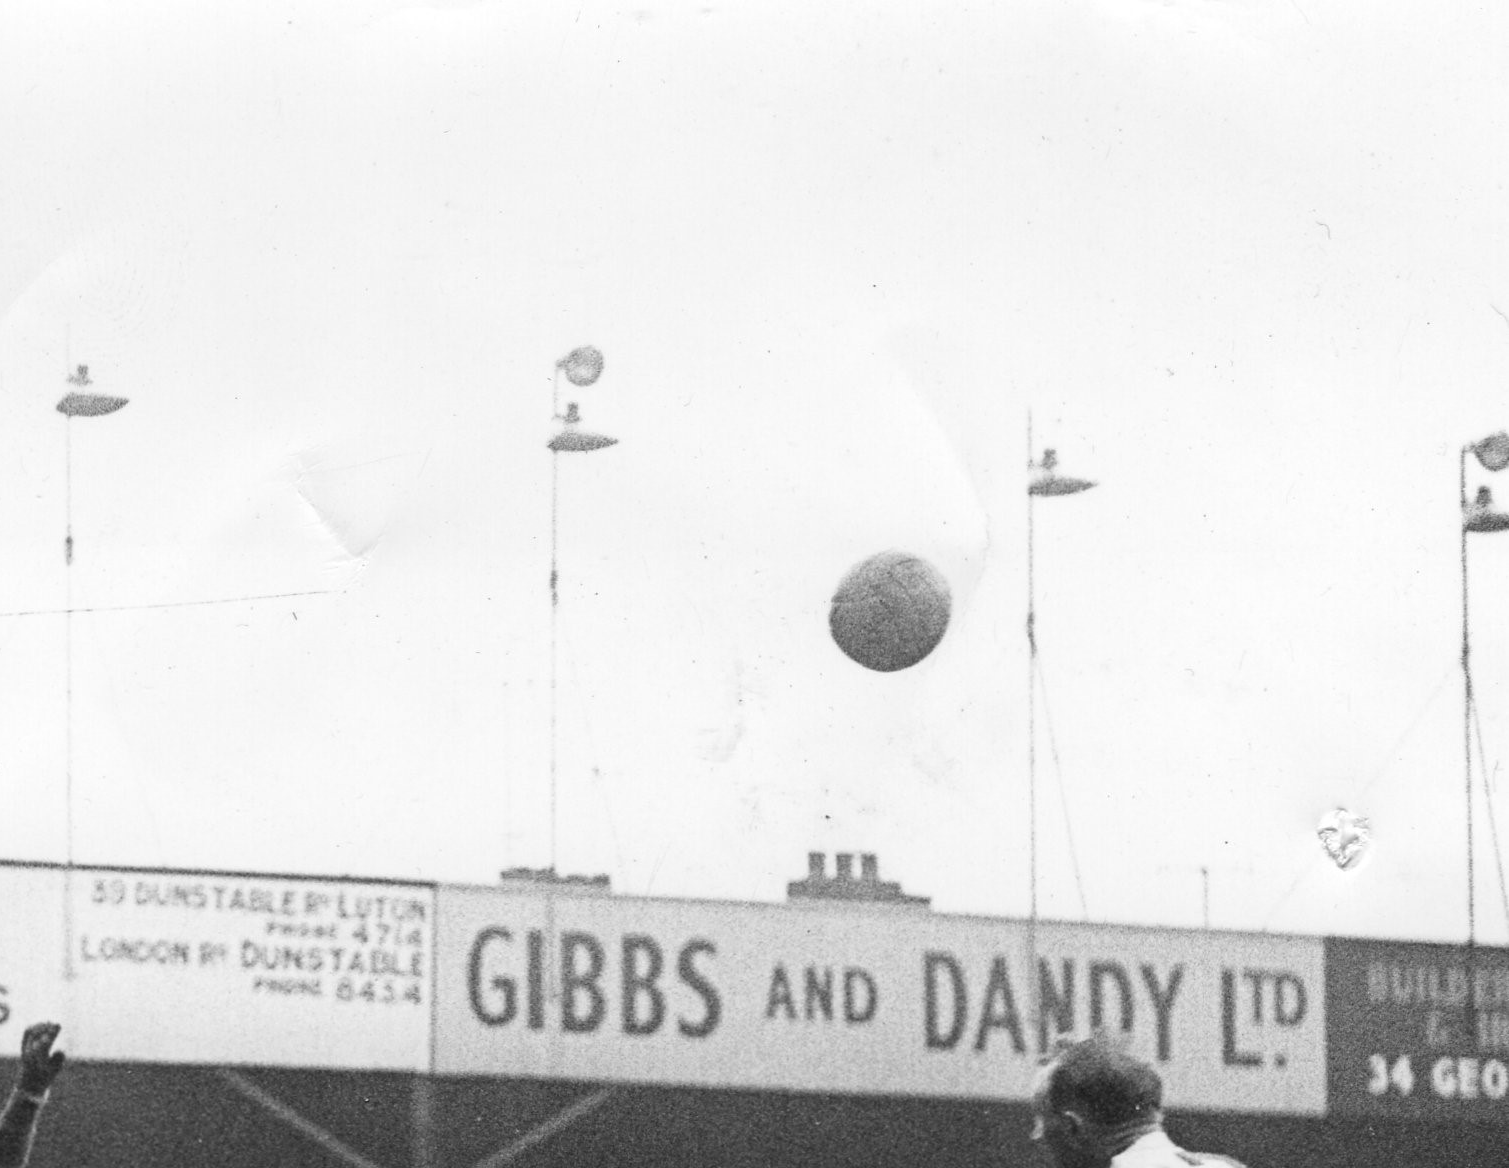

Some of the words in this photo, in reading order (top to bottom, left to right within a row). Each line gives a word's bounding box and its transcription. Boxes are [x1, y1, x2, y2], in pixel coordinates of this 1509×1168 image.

[135, 881, 295, 916] DUNSTABLE
[337, 892, 426, 922] LUTON
[80, 935, 190, 965] LONDON
[241, 938, 423, 978] DUNSTABLE
[466, 925, 723, 1039] GIBBS
[765, 961, 880, 1025] AND
[923, 949, 1184, 1062] DANDY
